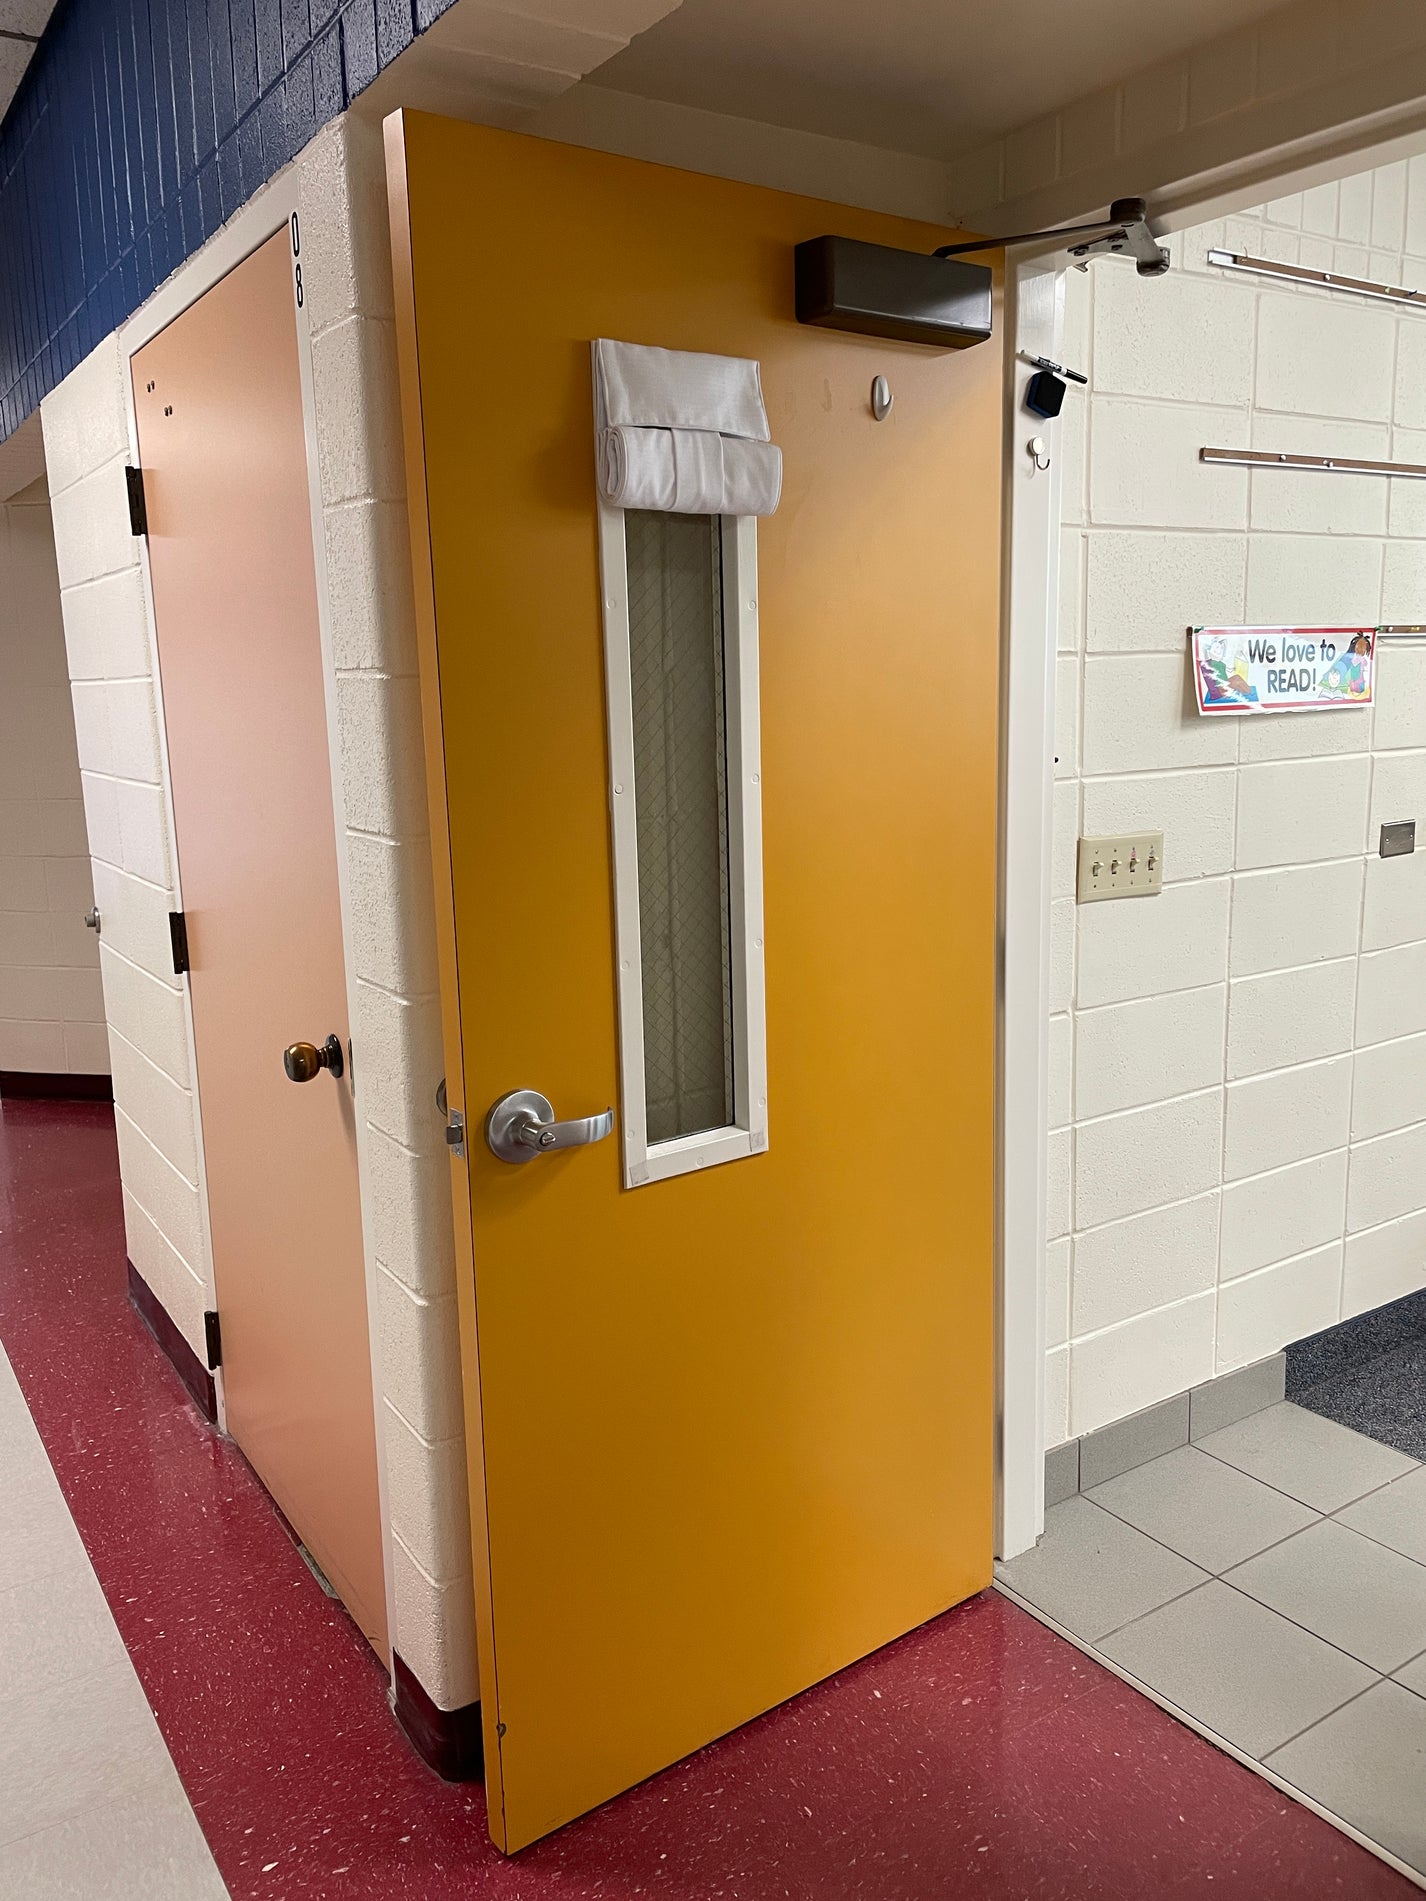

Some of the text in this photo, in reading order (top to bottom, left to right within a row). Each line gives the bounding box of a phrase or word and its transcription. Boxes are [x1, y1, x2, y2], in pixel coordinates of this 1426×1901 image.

[1247, 638, 1336, 664] We love to
[1267, 669, 1317, 693] READ!
